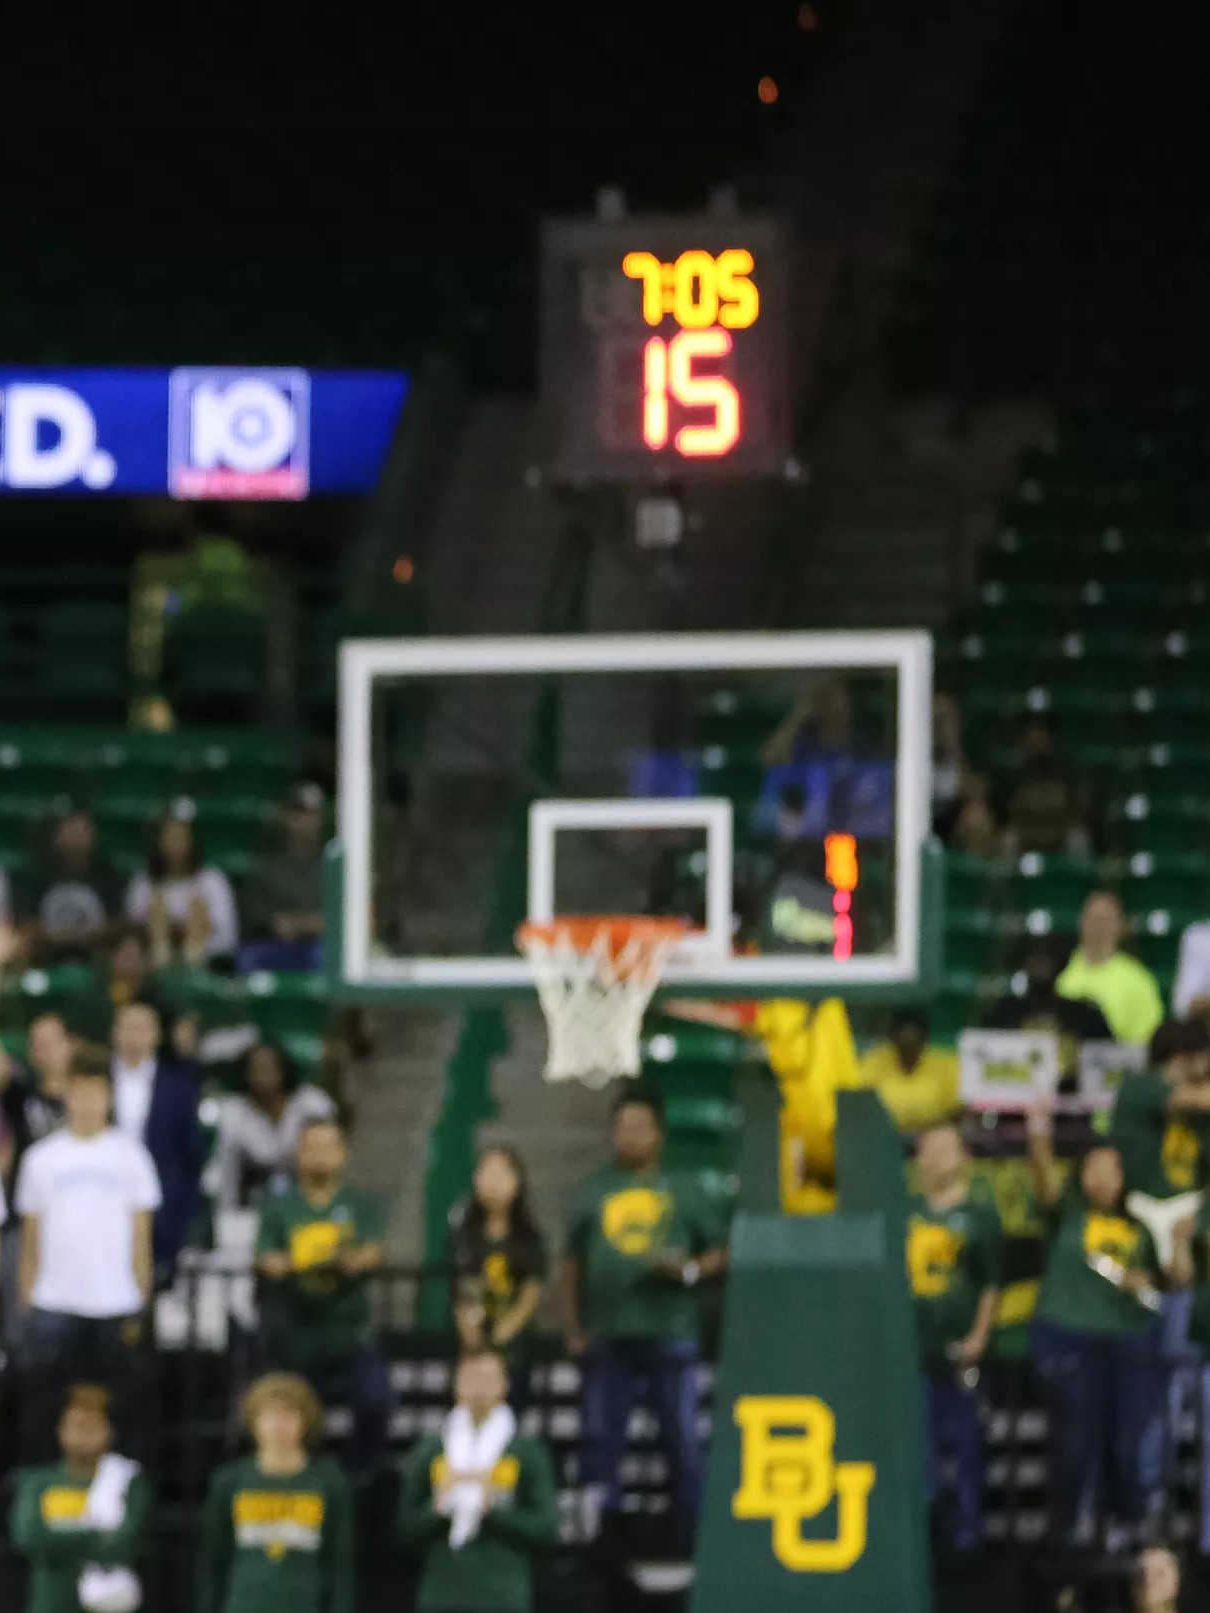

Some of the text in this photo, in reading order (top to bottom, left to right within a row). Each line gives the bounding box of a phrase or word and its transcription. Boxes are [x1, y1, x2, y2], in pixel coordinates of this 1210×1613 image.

[622, 249, 759, 329] 7:05
[643, 327, 741, 457] 15
[732, 1394, 876, 1572] BU
